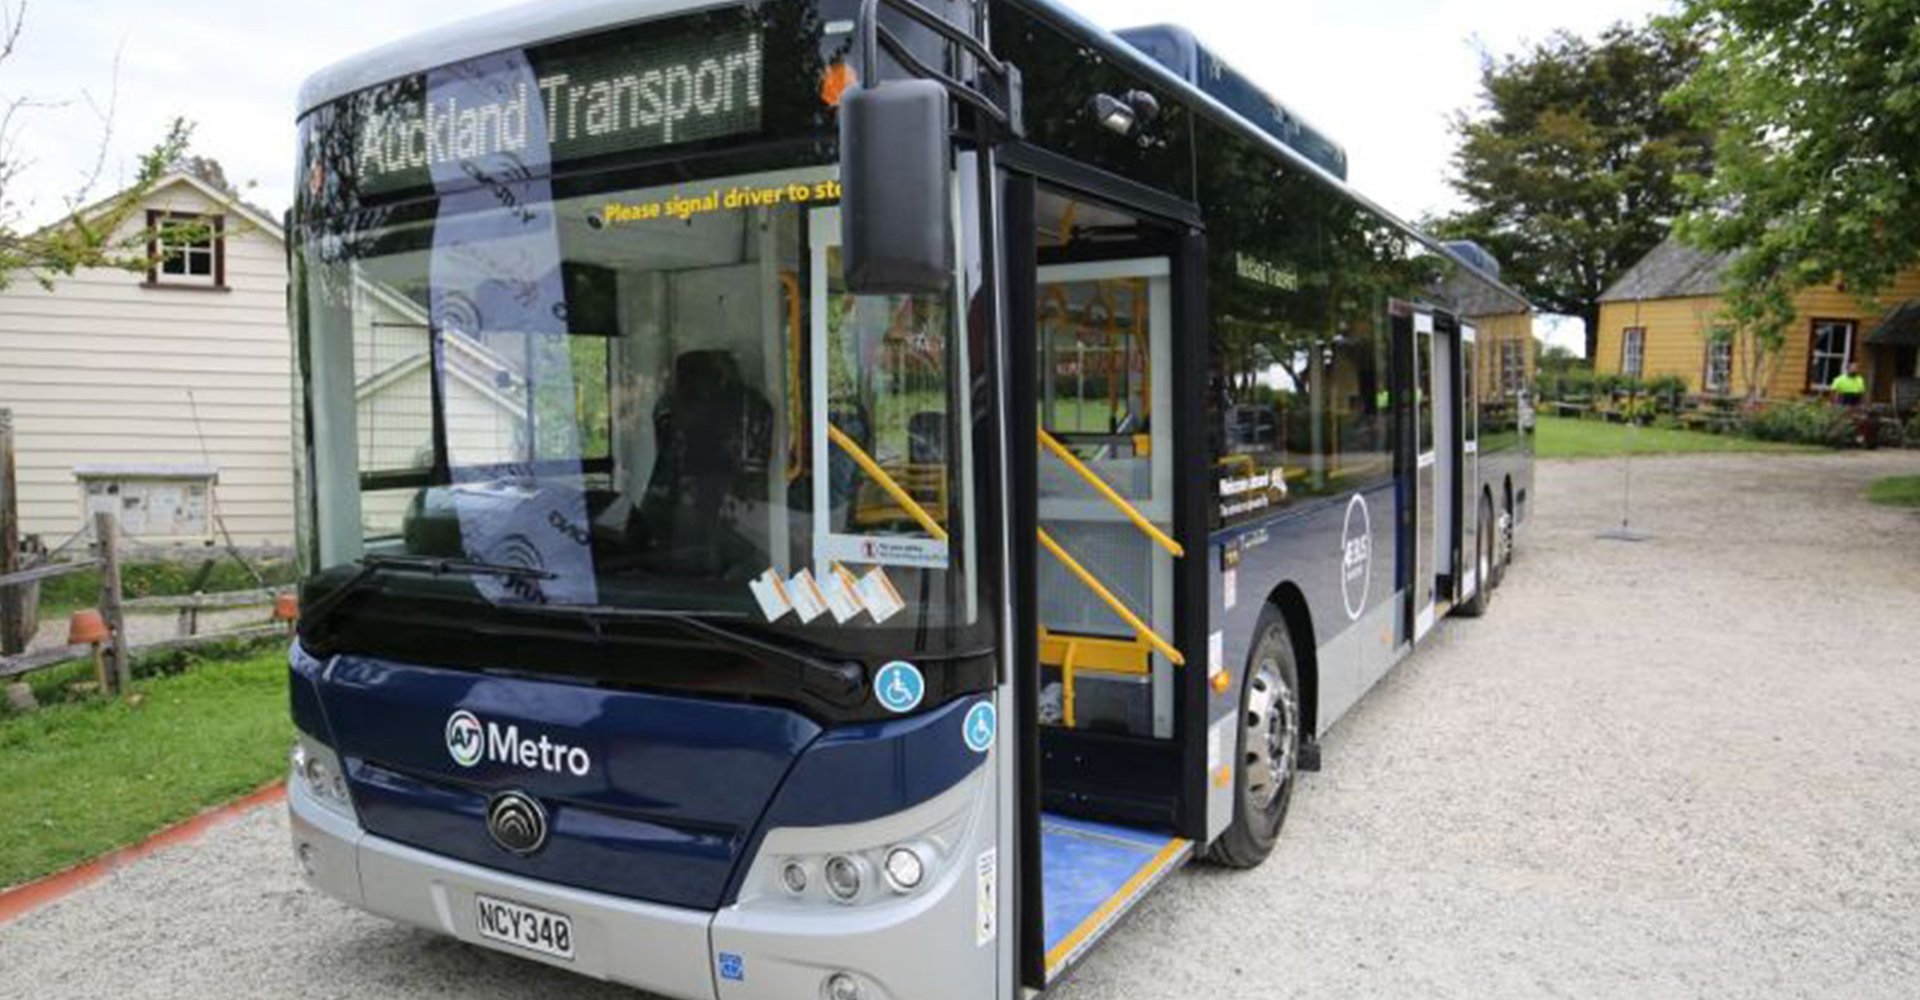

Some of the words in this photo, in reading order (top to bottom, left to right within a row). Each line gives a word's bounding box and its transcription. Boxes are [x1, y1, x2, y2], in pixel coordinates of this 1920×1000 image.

[357, 82, 527, 178] Auckland
[539, 33, 763, 144] Transport
[604, 202, 660, 222] Please
[664, 190, 719, 219] signal
[724, 186, 784, 209] driver
[787, 182, 809, 201] to
[488, 722, 591, 776] Metro
[478, 900, 571, 951] NCY340
